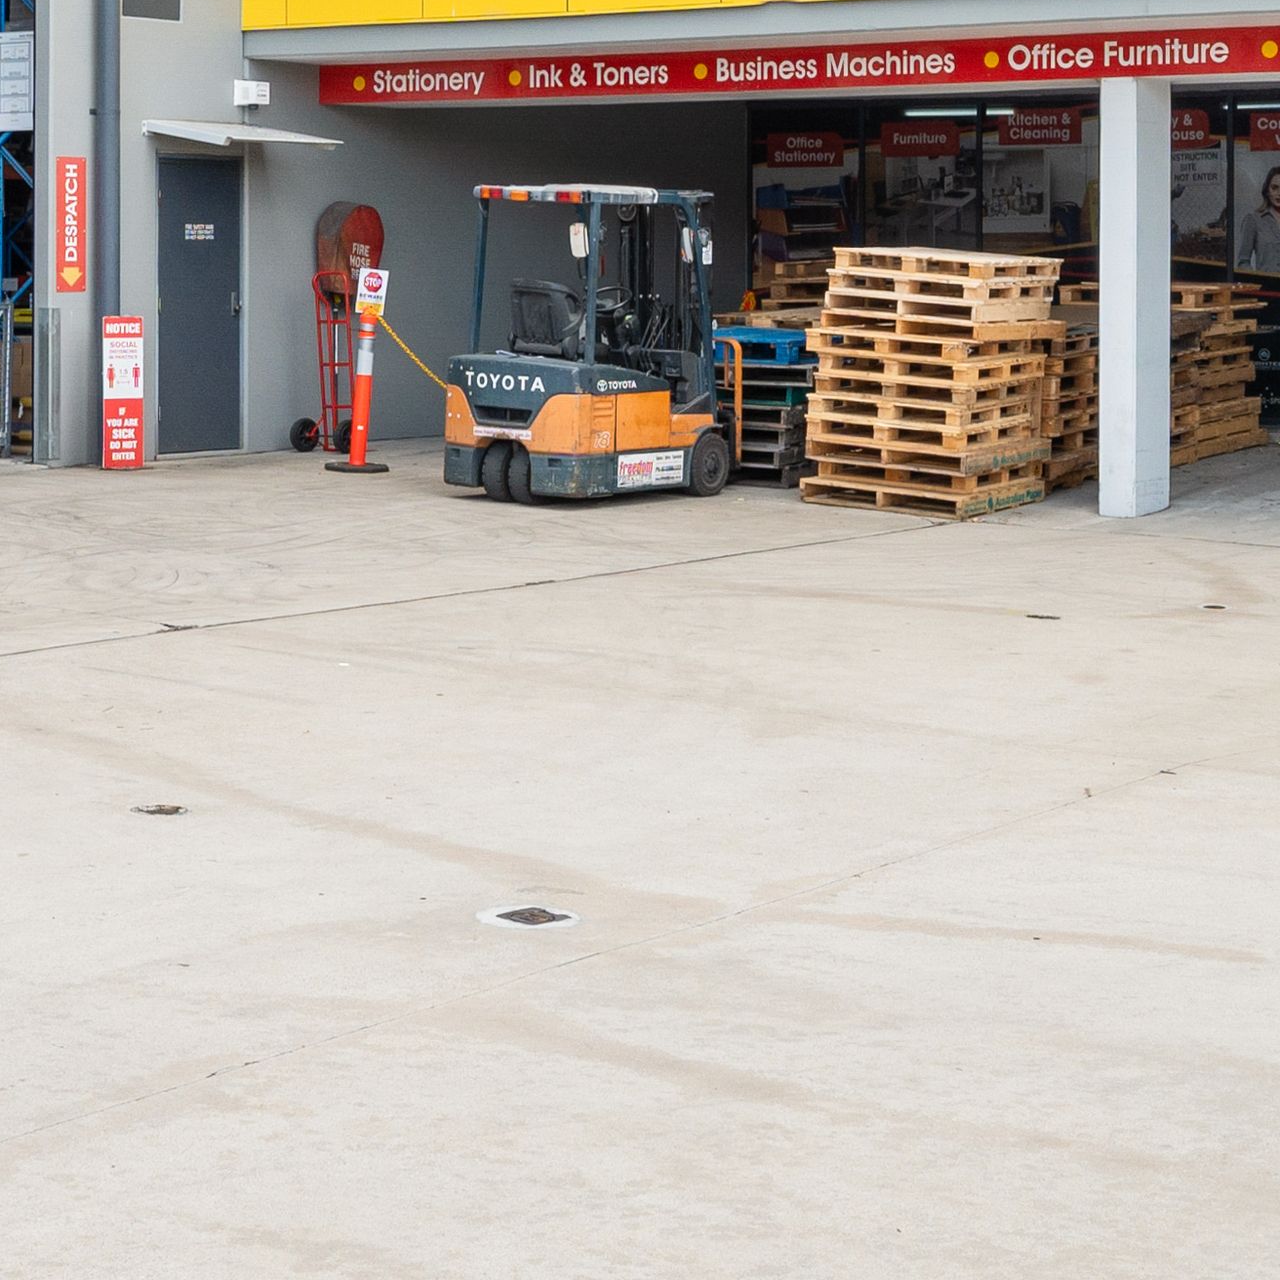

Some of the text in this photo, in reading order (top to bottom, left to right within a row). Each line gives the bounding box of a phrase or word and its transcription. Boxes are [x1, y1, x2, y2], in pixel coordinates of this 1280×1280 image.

[1007, 34, 1230, 72] Office Furniture
[716, 48, 956, 82] Business Machines
[373, 66, 484, 96] Stationery
[528, 61, 669, 88] Ink & Toners
[1008, 112, 1071, 125] Kitchen &
[893, 132, 947, 145] Furniture
[1010, 127, 1071, 142] Cleaning
[786, 136, 823, 149] Office
[774, 150, 836, 165] Stationery
[65, 163, 78, 263] DESPATCH
[352, 242, 371, 257] FIRE
[350, 255, 371, 268] HOSE
[365, 277, 382, 288] STOP
[106, 322, 141, 334] NOTICE
[466, 371, 545, 392] TOYOTA
[608, 379, 637, 390] TOYOTA
[119, 407, 126, 416] IF
[112, 429, 135, 439] SICK
[110, 441, 137, 449] DO NOT
[112, 452, 135, 461] ENTER
